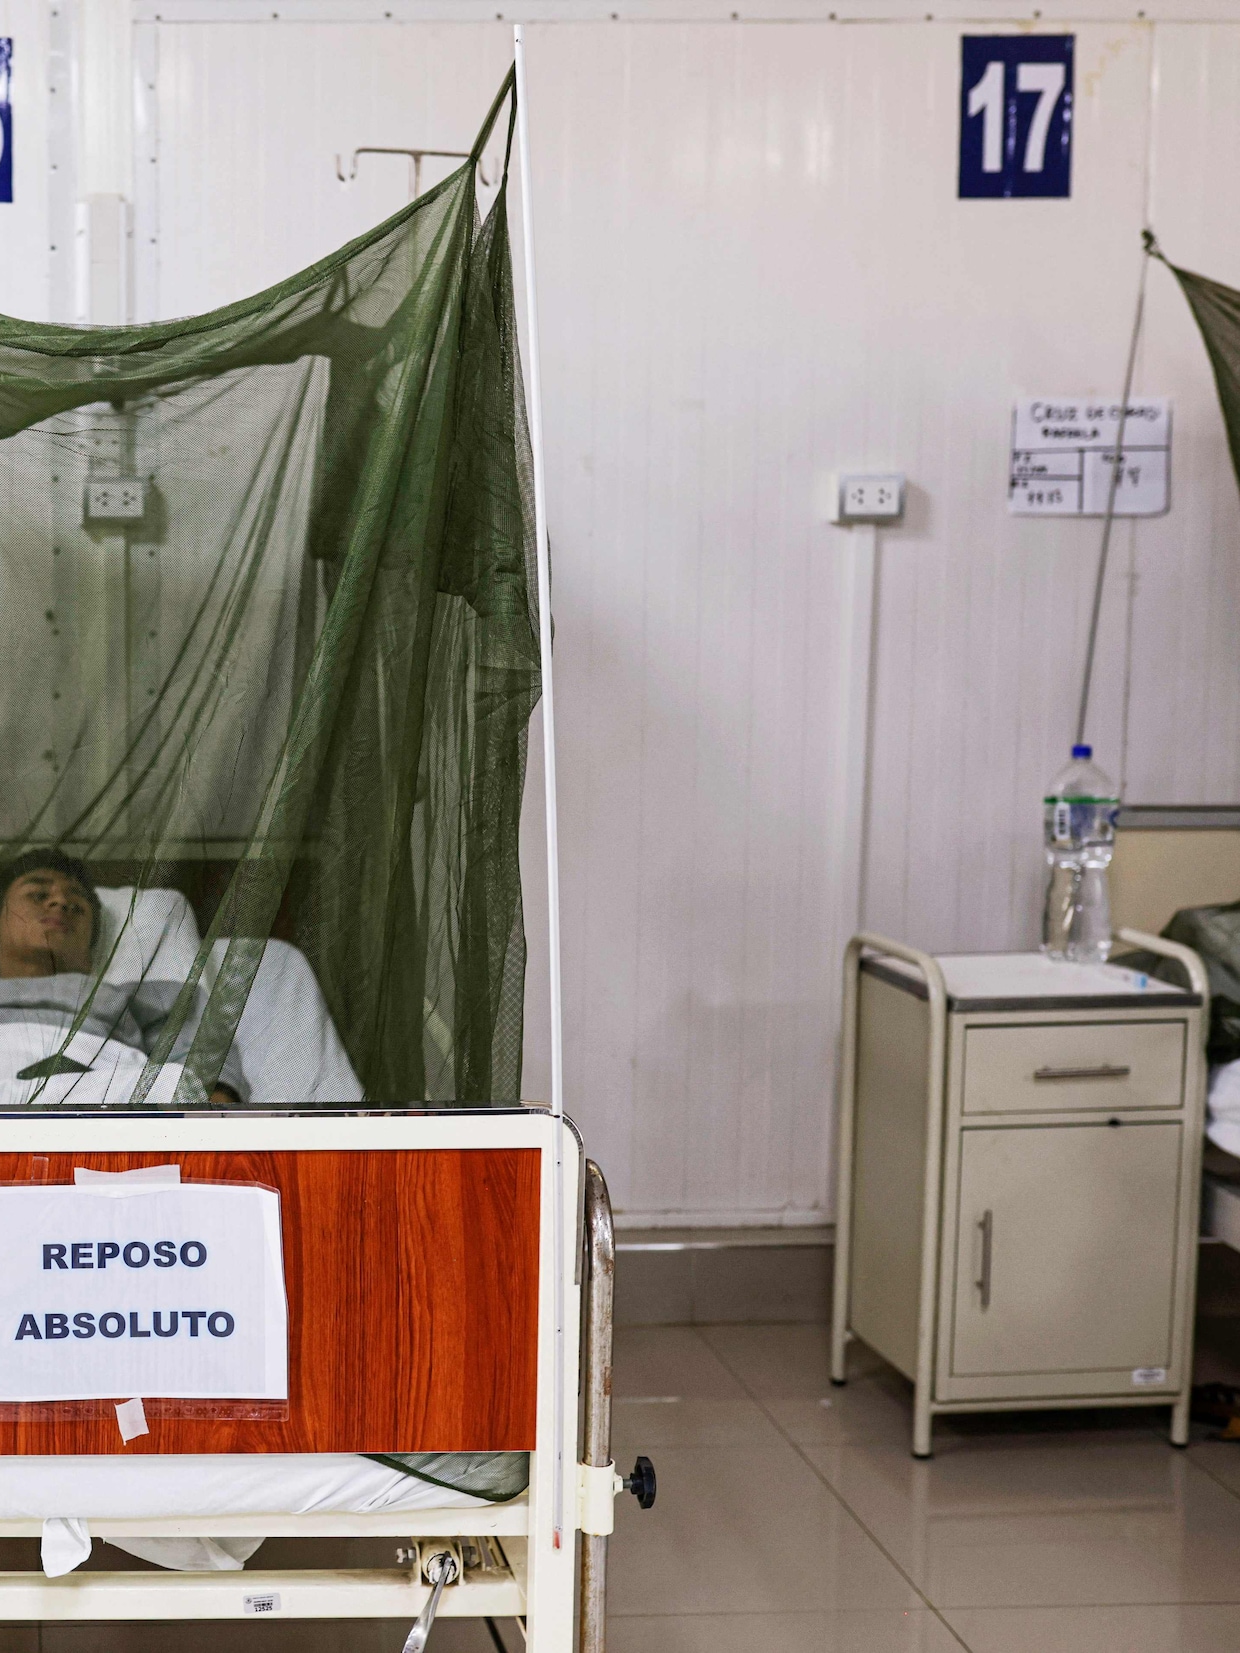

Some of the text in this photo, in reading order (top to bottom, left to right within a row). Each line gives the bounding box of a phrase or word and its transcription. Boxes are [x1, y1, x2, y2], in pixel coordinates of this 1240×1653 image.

[967, 60, 1066, 173] 17
[41, 1240, 208, 1270] REPOSO
[13, 1310, 236, 1341] ABSOLUTO
